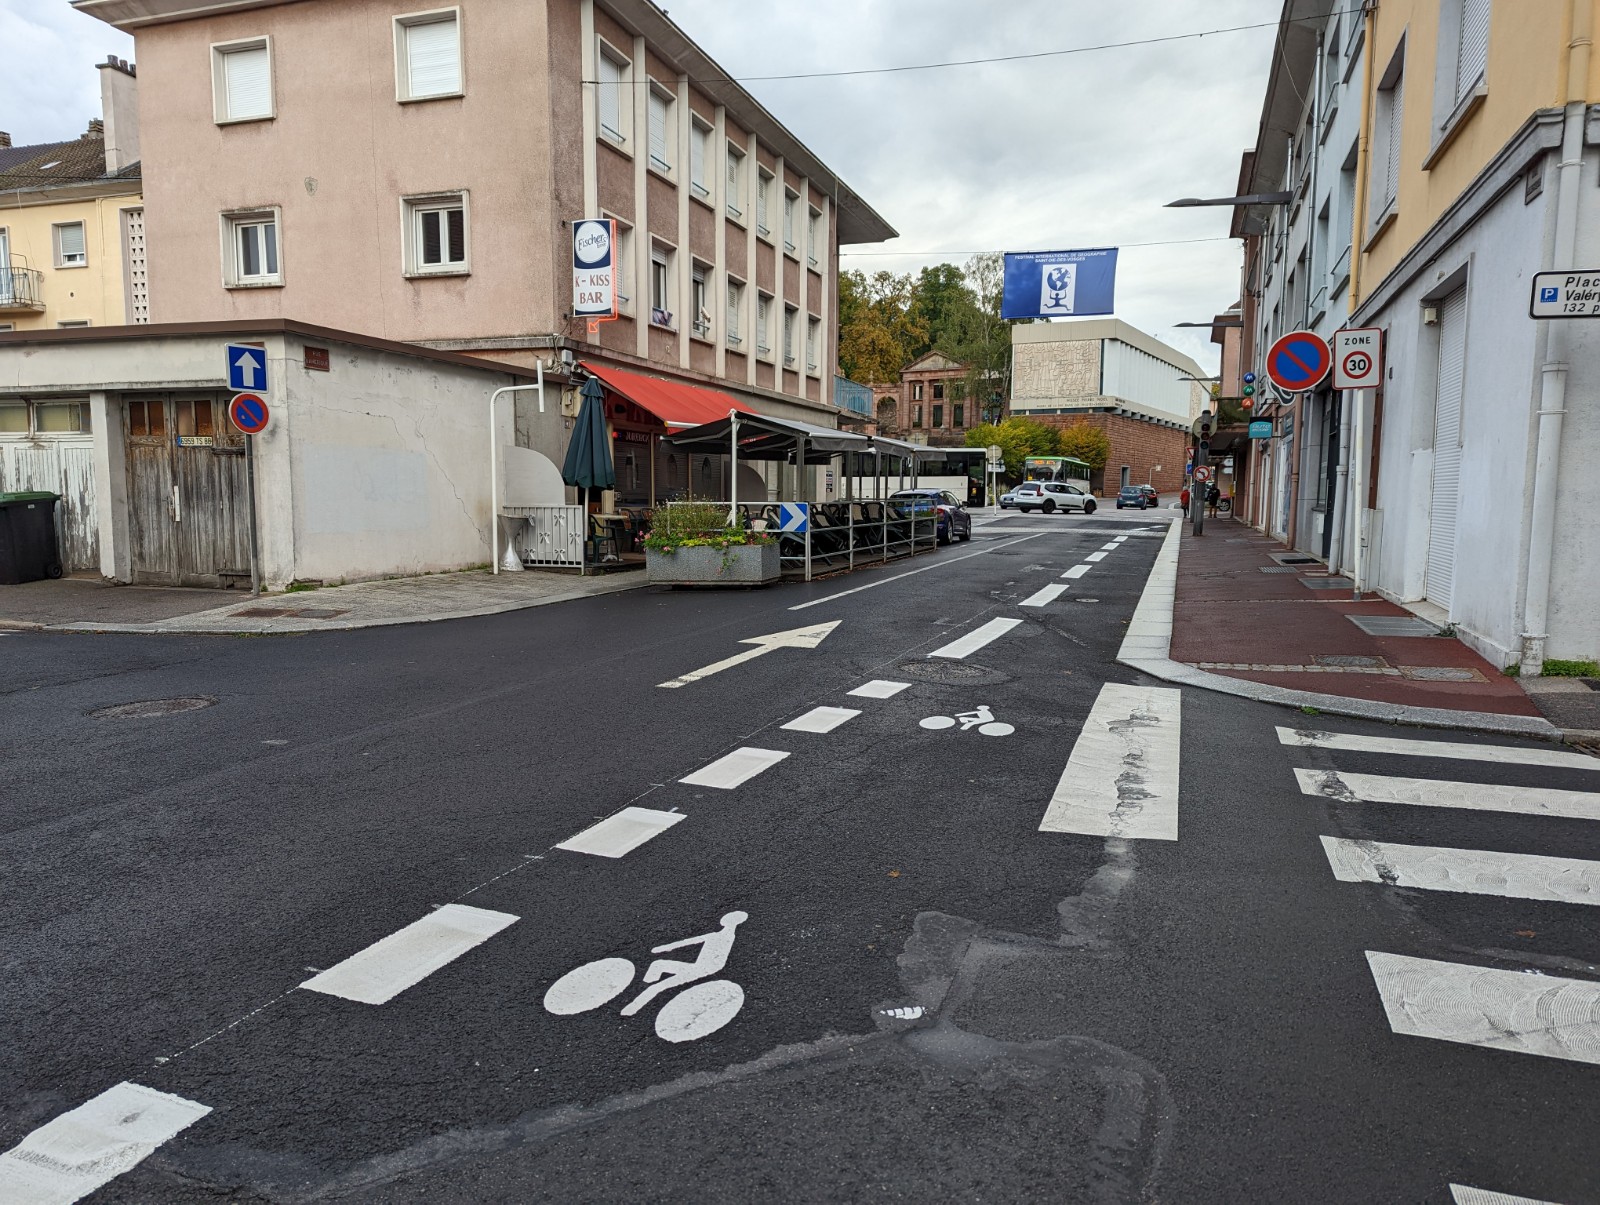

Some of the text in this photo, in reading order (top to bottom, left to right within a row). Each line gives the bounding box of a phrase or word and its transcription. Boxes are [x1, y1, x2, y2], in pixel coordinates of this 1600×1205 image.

[589, 274, 610, 287] KISS
[579, 291, 604, 305] BAR
[1563, 303, 1586, 312] 132
[1344, 336, 1371, 345] ZONE
[1348, 359, 1367, 372] 30
